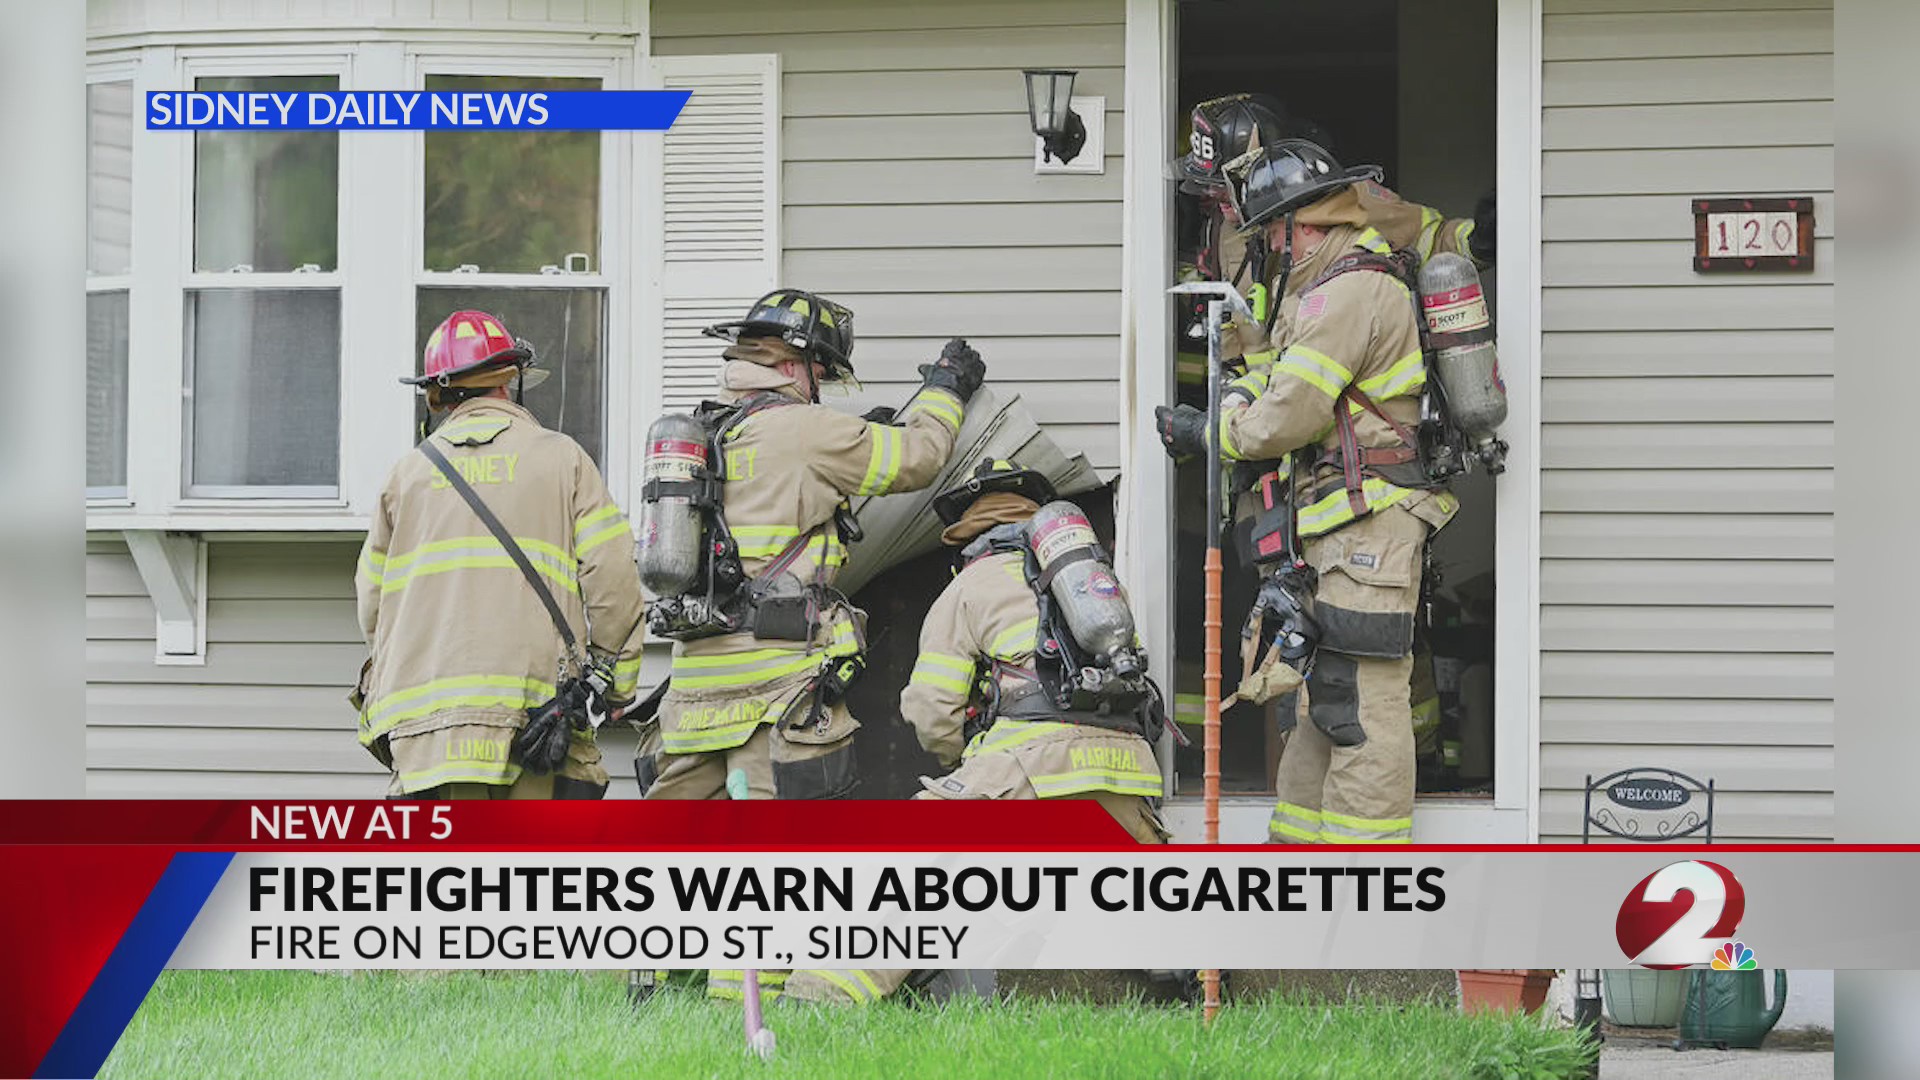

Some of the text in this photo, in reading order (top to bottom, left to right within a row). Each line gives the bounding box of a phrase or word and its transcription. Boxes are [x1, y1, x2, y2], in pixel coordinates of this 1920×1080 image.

[1718, 219, 1792, 251] 120
[431, 451, 519, 491] SDNEY
[446, 739, 507, 761] LUNDY
[1615, 787, 1682, 802] WELCOME
